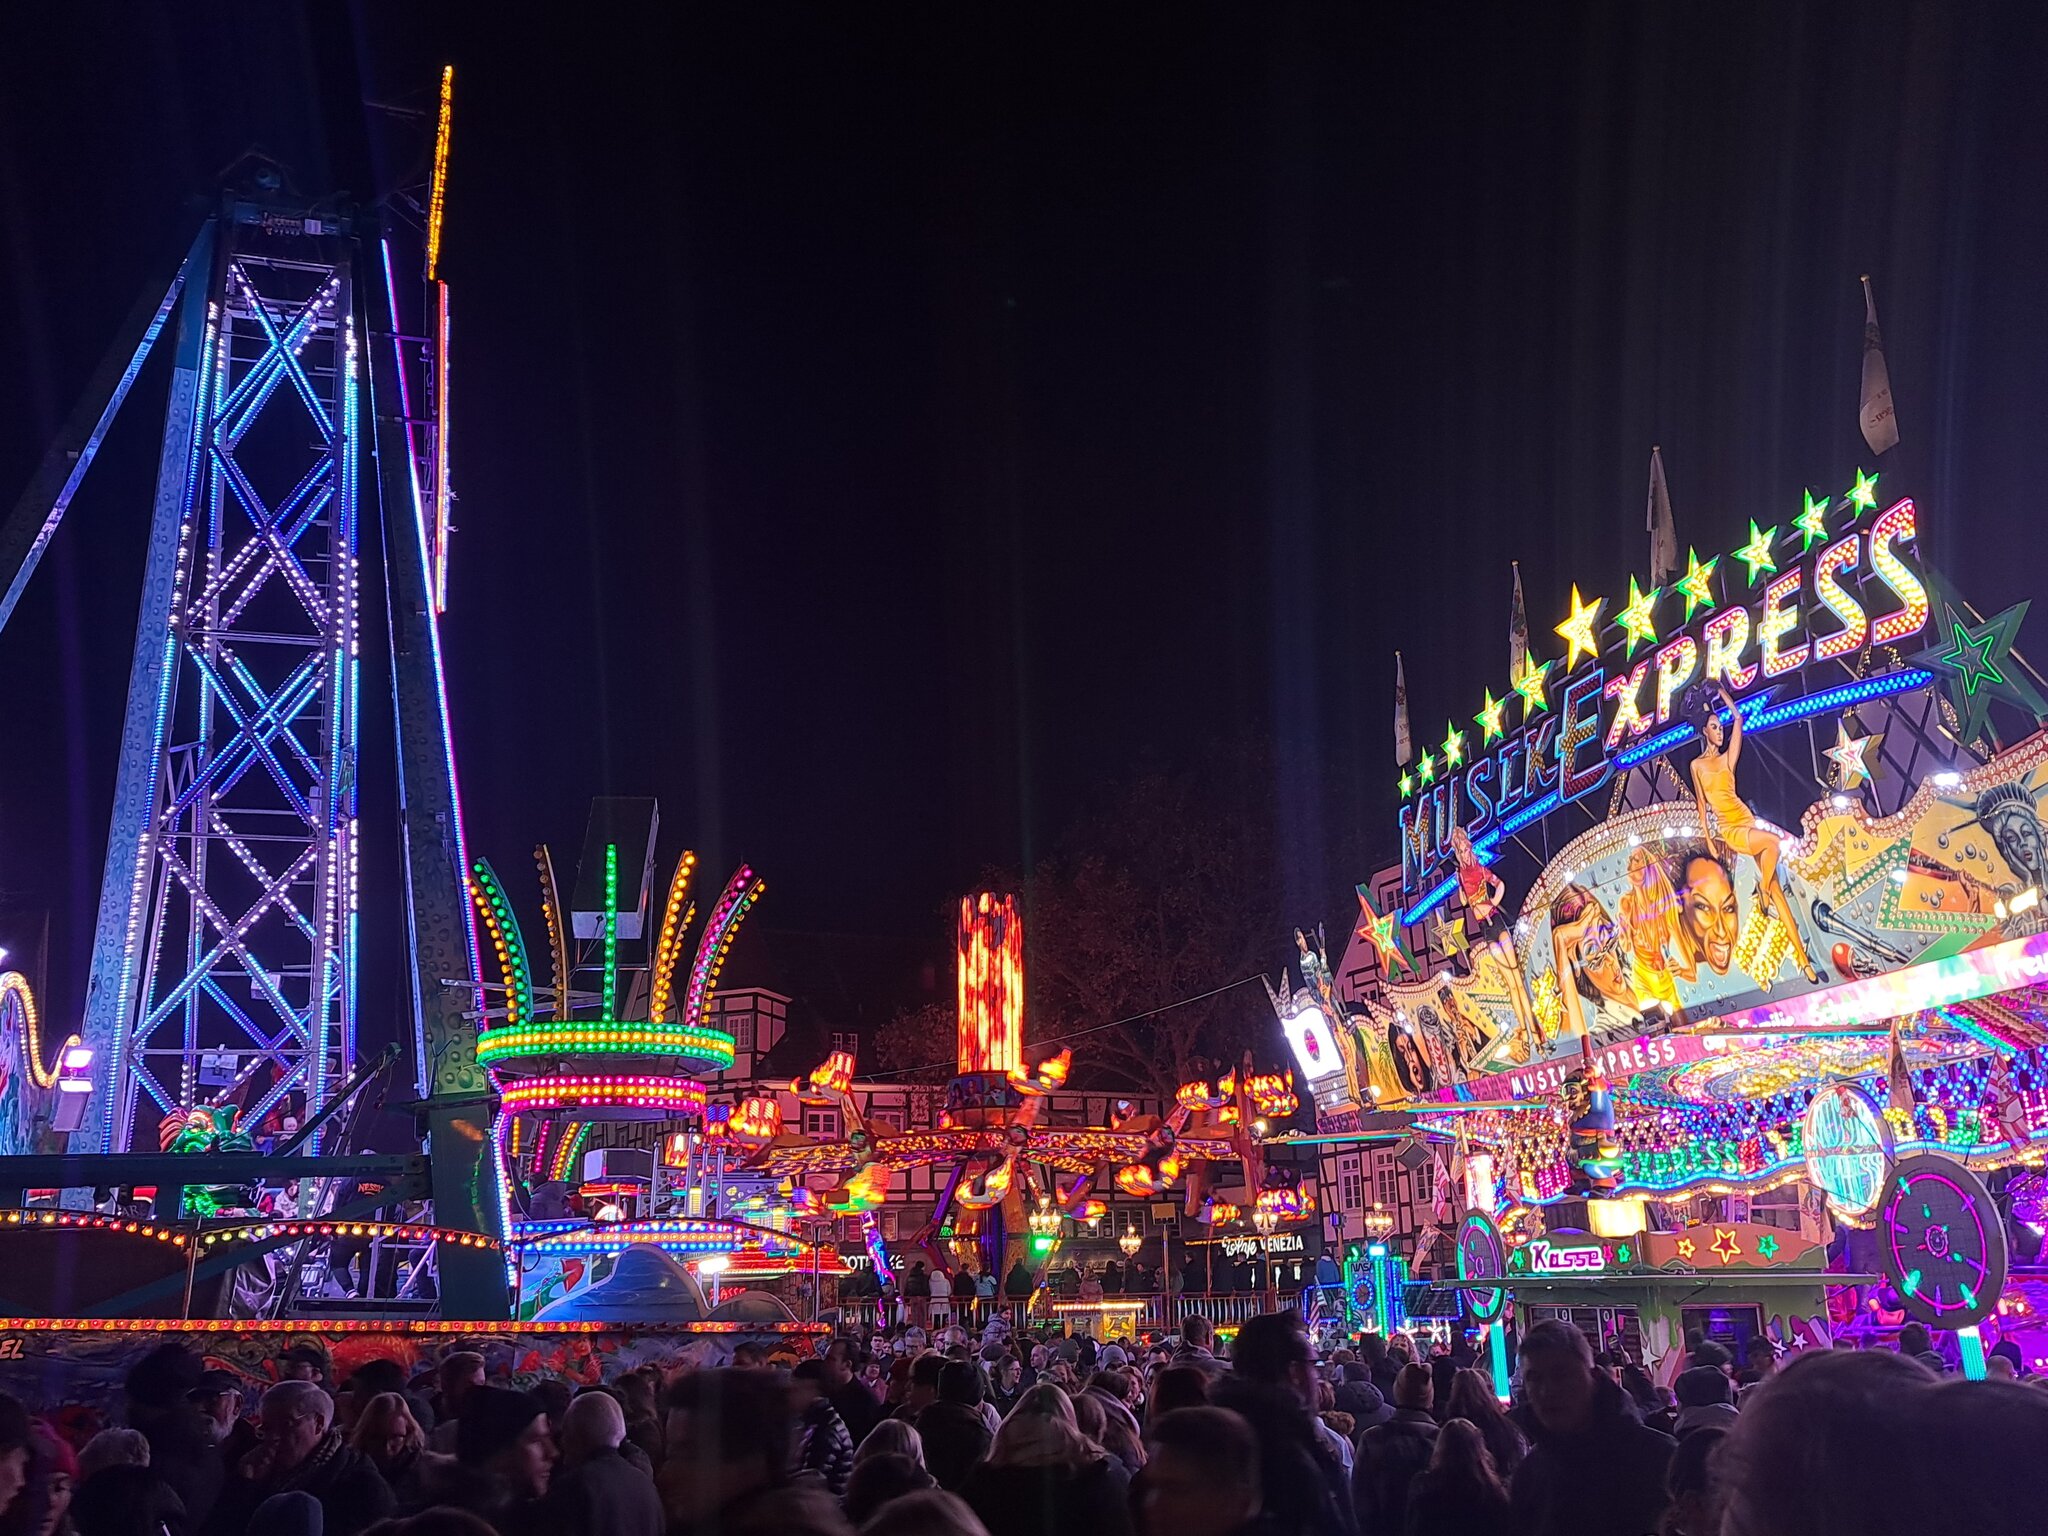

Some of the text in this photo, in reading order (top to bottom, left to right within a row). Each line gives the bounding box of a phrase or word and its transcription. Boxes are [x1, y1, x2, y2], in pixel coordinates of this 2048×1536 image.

[1582, 1038, 1676, 1078] XPRESS
[1260, 1235, 1304, 1253] VENEZIA
[1531, 1240, 1604, 1271] Kasse
